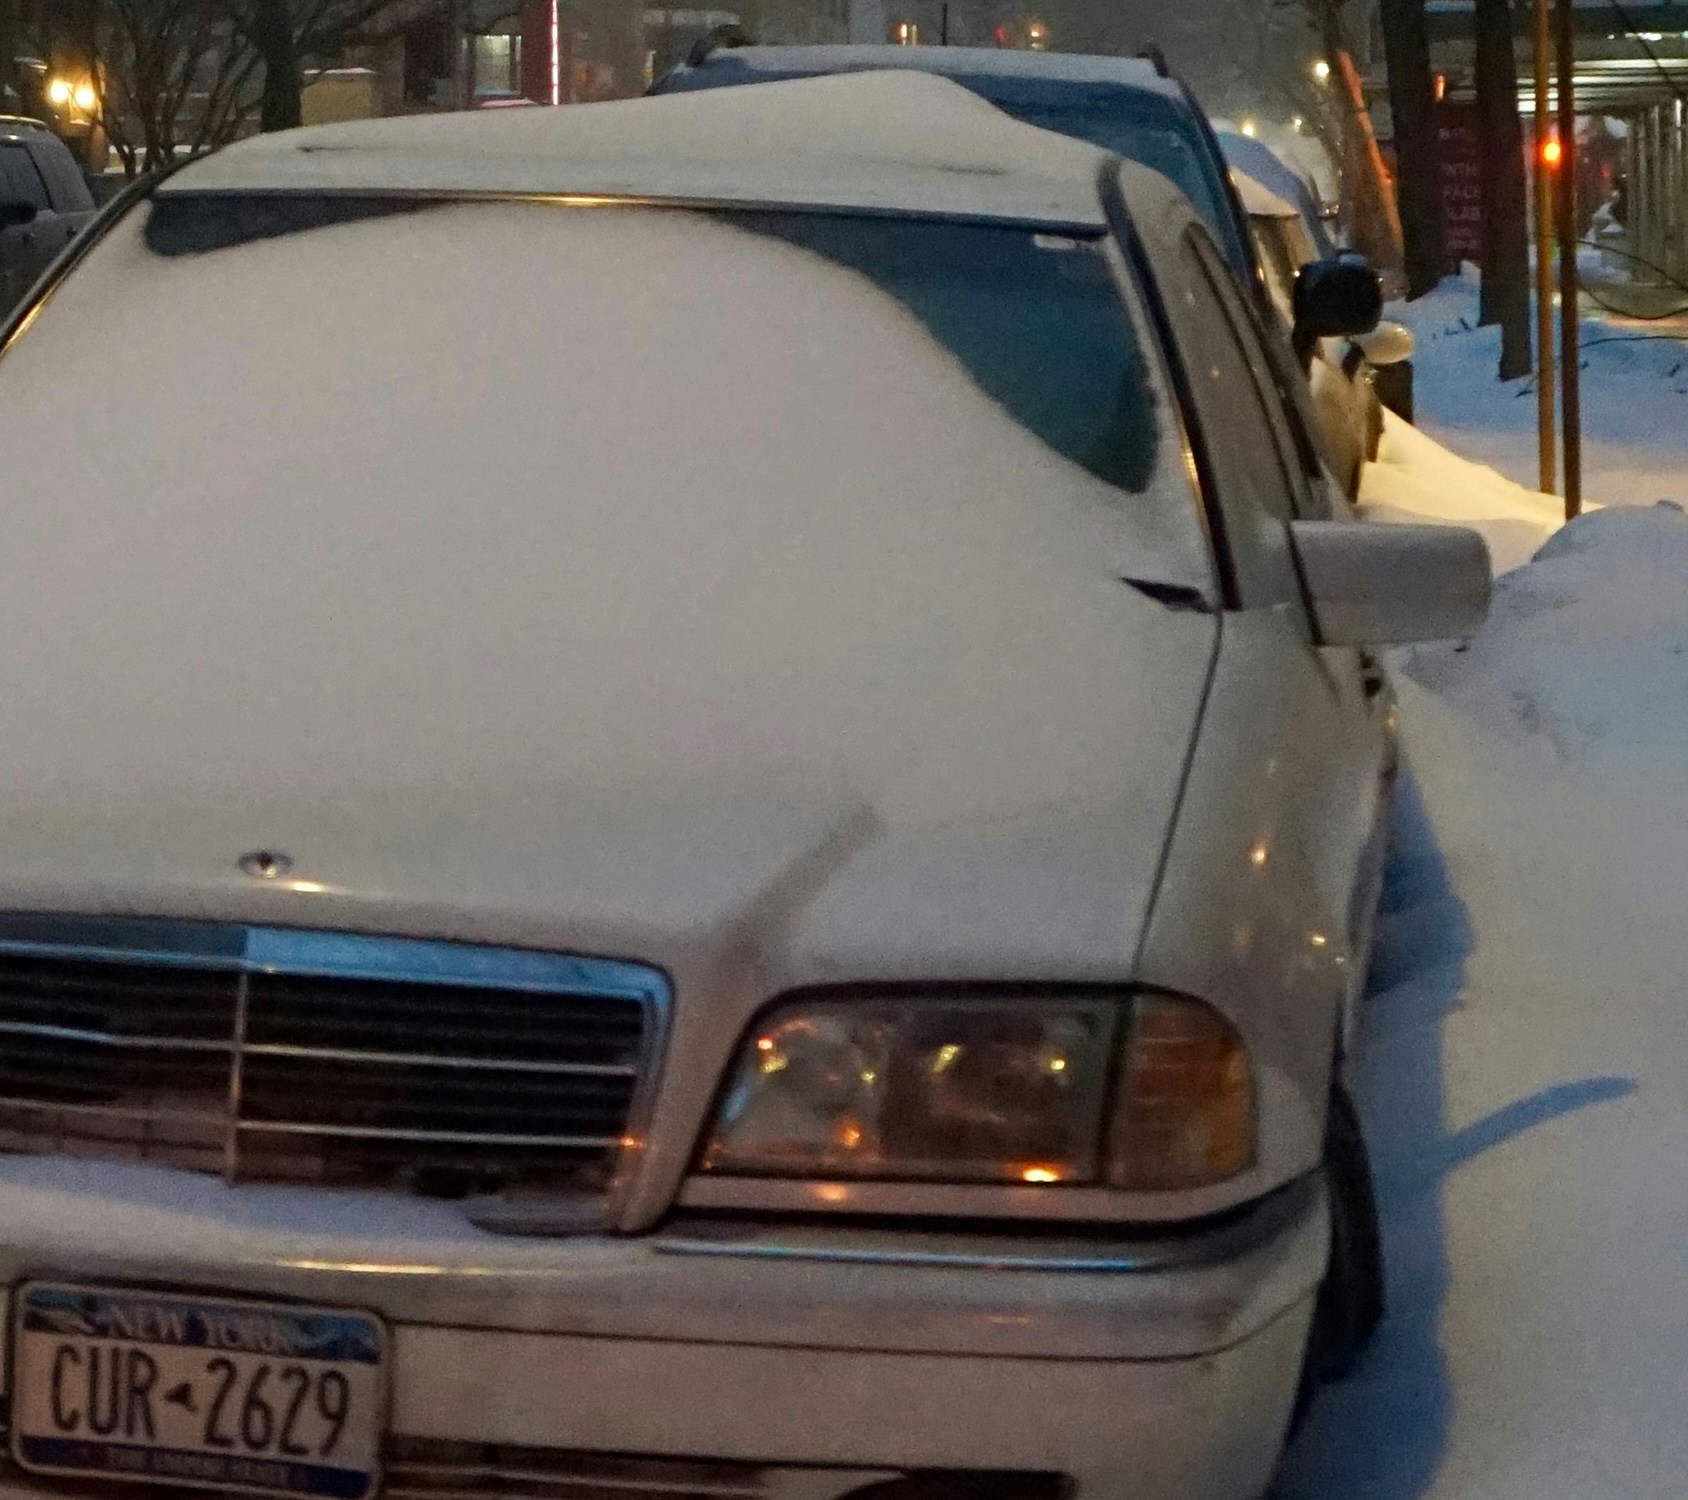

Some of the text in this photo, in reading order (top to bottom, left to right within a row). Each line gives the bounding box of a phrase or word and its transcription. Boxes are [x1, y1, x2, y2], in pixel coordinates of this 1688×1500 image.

[108, 1302, 187, 1342] NEW
[51, 1343, 350, 1457] CUR 2629
